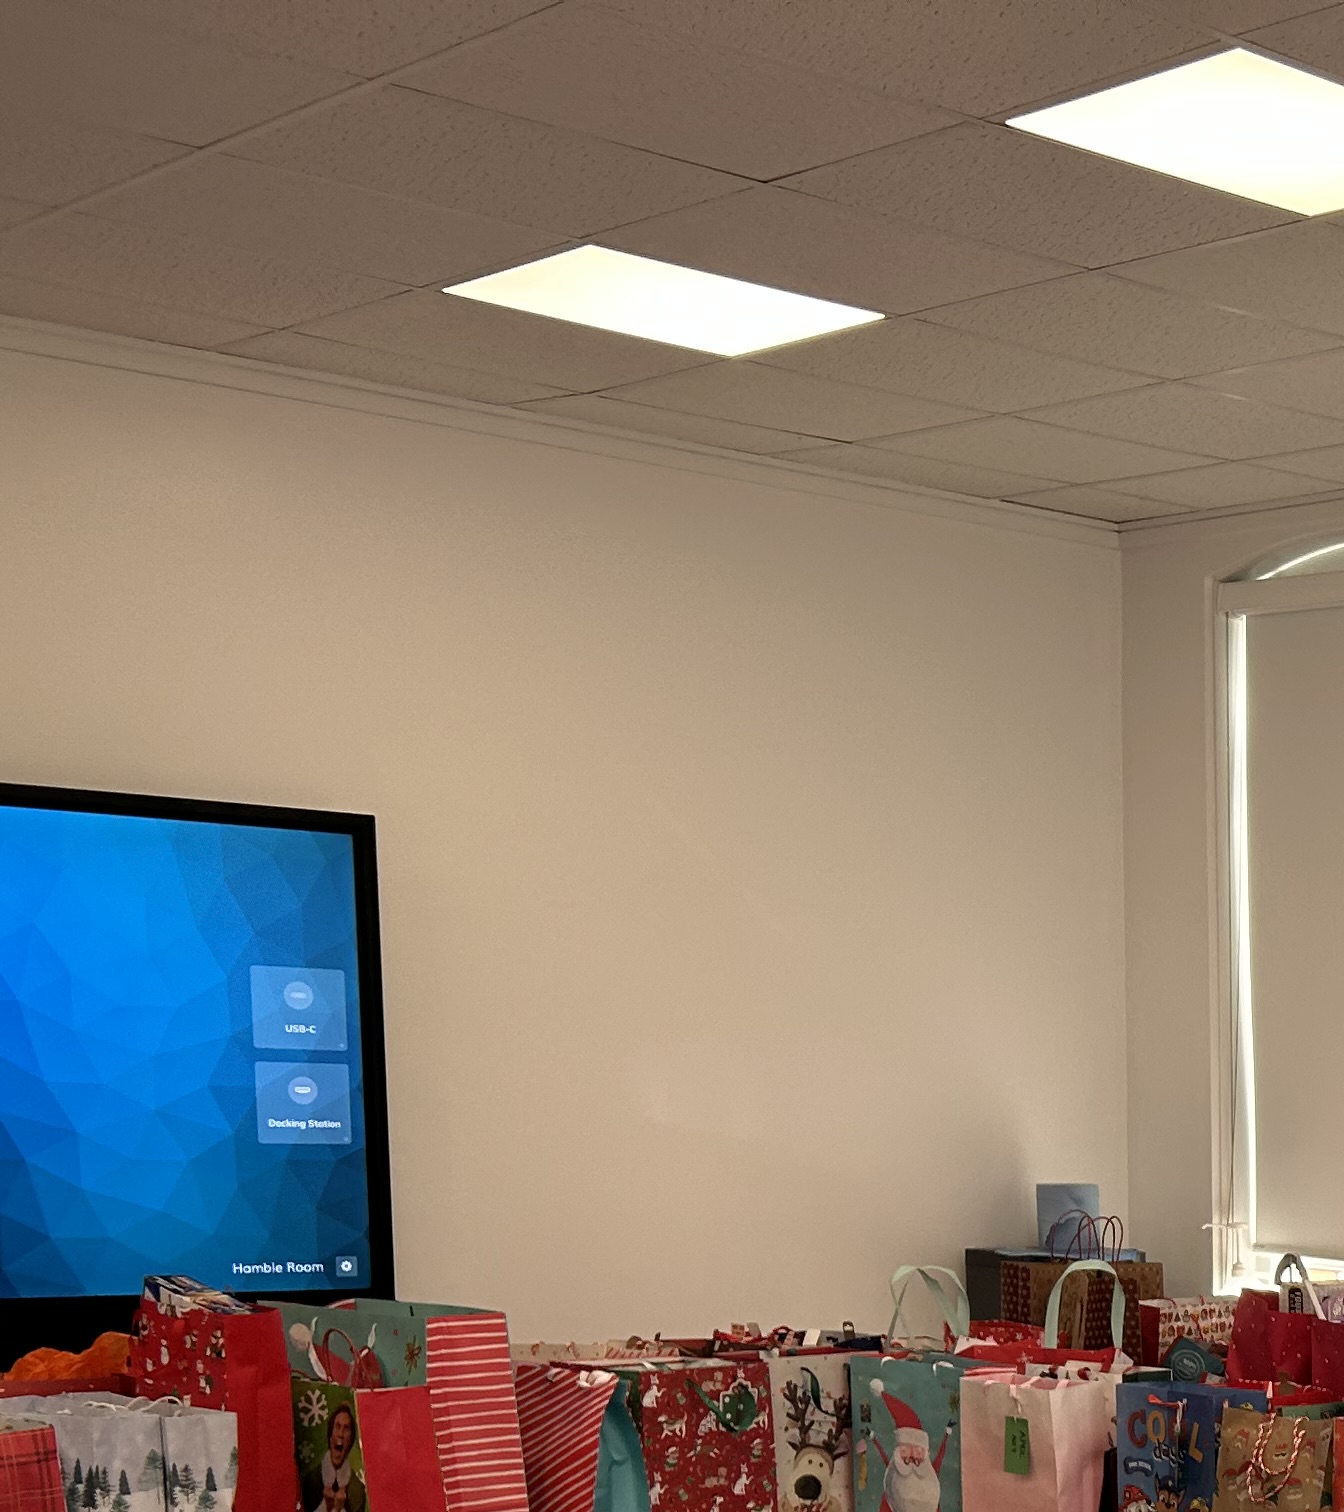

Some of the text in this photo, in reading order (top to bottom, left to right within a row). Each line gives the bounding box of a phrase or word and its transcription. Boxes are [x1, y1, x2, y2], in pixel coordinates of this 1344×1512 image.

[285, 1024, 316, 1034] USB-C
[268, 1119, 341, 1130] Docking Station
[232, 1262, 324, 1274] Hamble Room
